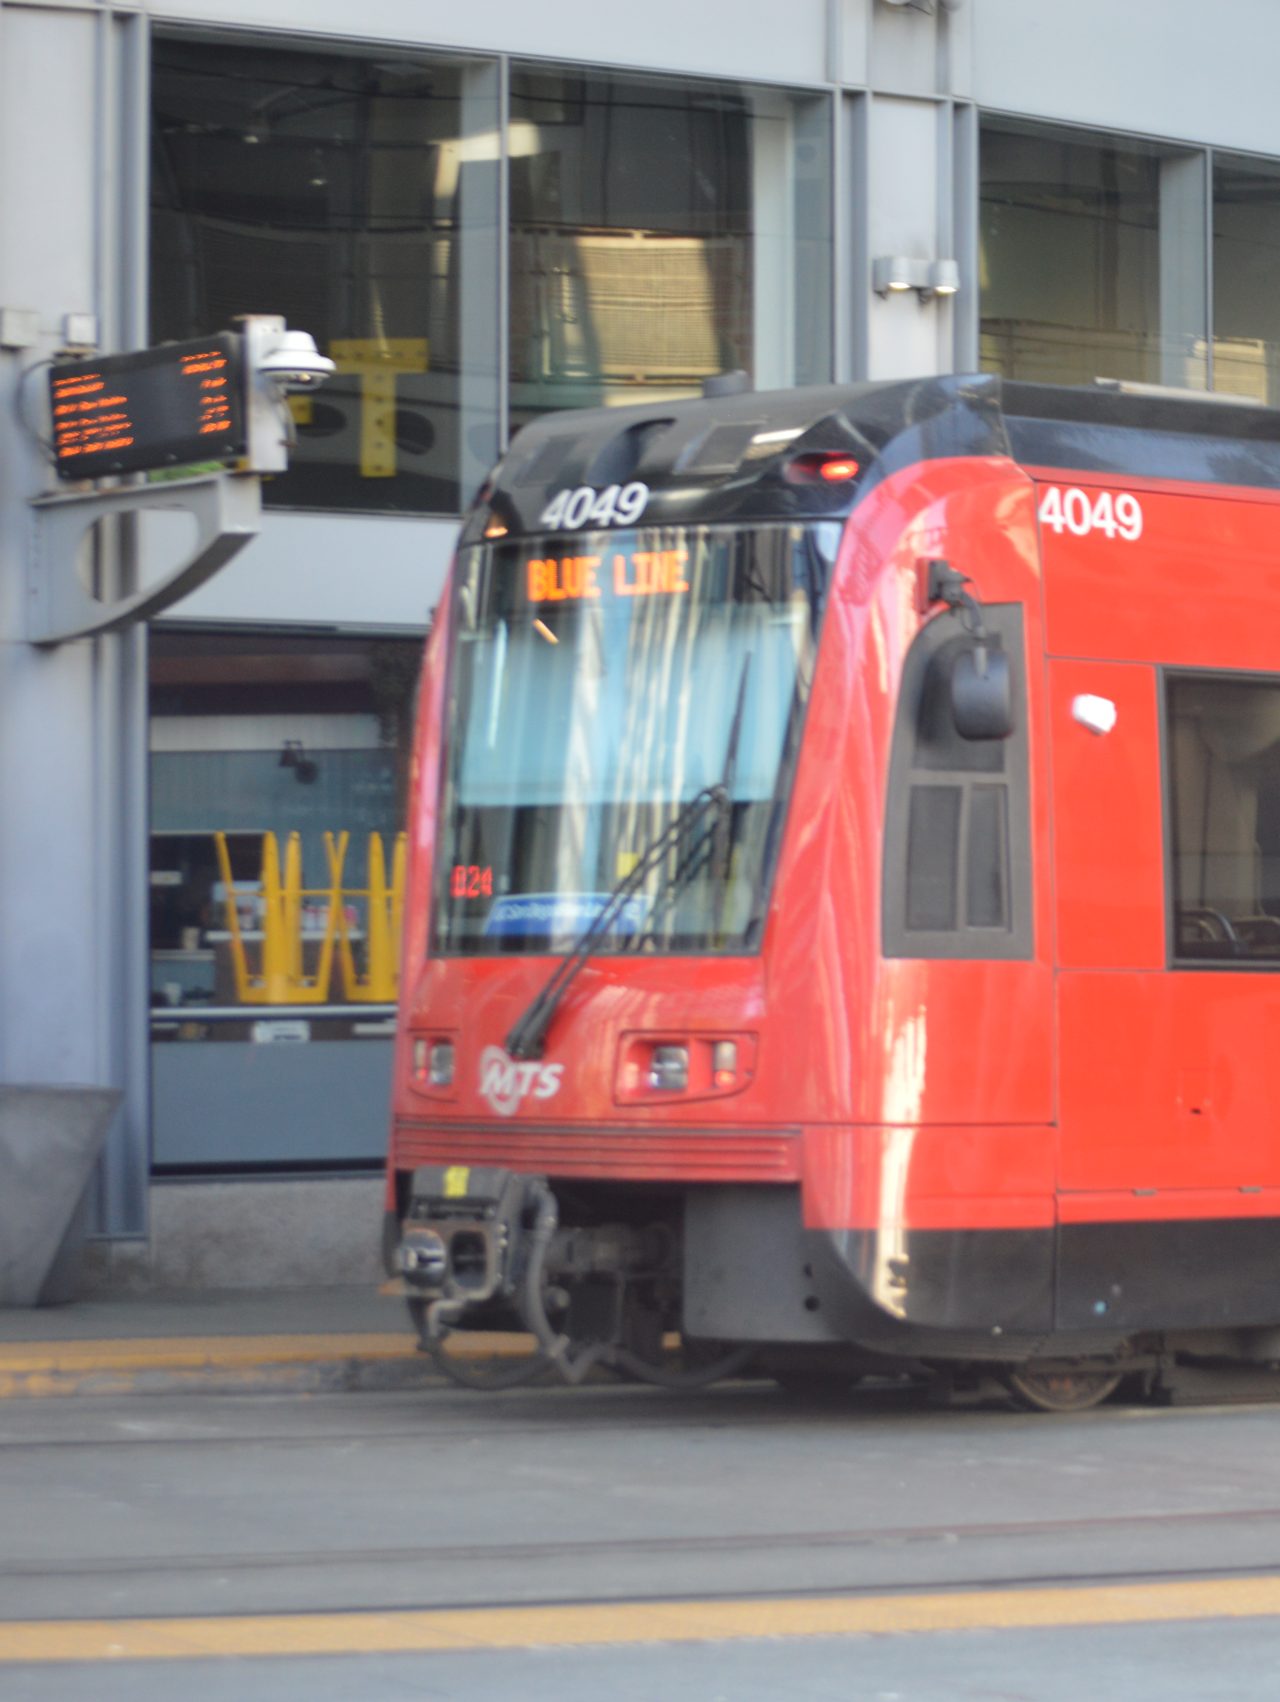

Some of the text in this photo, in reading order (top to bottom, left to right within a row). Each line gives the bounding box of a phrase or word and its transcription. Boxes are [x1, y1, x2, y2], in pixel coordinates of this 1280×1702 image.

[540, 481, 649, 530] 4049
[1038, 487, 1143, 541] 4049
[528, 551, 689, 602] BLUE LINE
[479, 1061, 565, 1099] MTS
